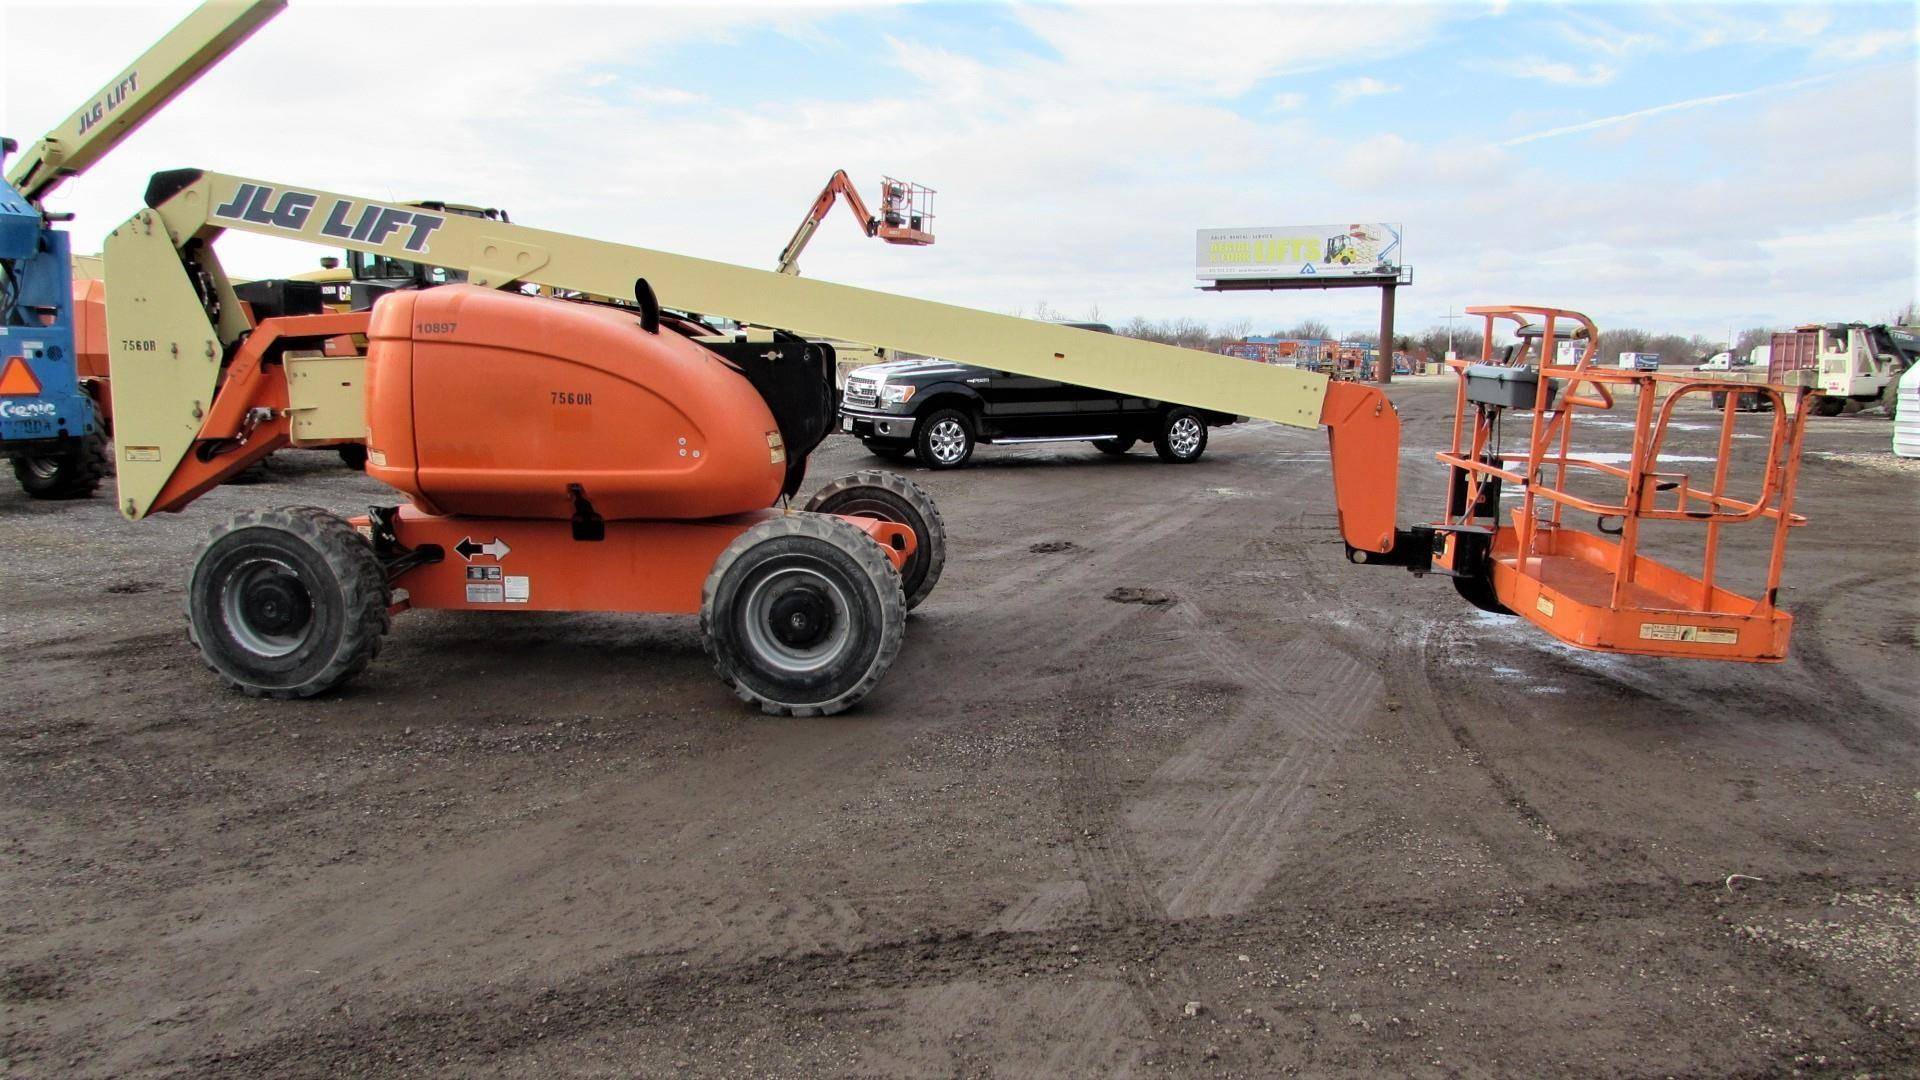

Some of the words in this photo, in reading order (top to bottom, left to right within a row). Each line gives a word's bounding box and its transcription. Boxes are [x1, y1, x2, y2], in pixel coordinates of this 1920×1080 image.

[79, 101, 103, 136] JLG
[107, 71, 137, 112] LIFT
[215, 183, 318, 231] JLG
[320, 200, 445, 251] LIFT
[1254, 239, 1321, 263] LIFTS
[416, 322, 457, 334] 10897
[122, 340, 157, 352] 7560R
[551, 391, 593, 405] 7560R
[0, 400, 56, 418] Genie
